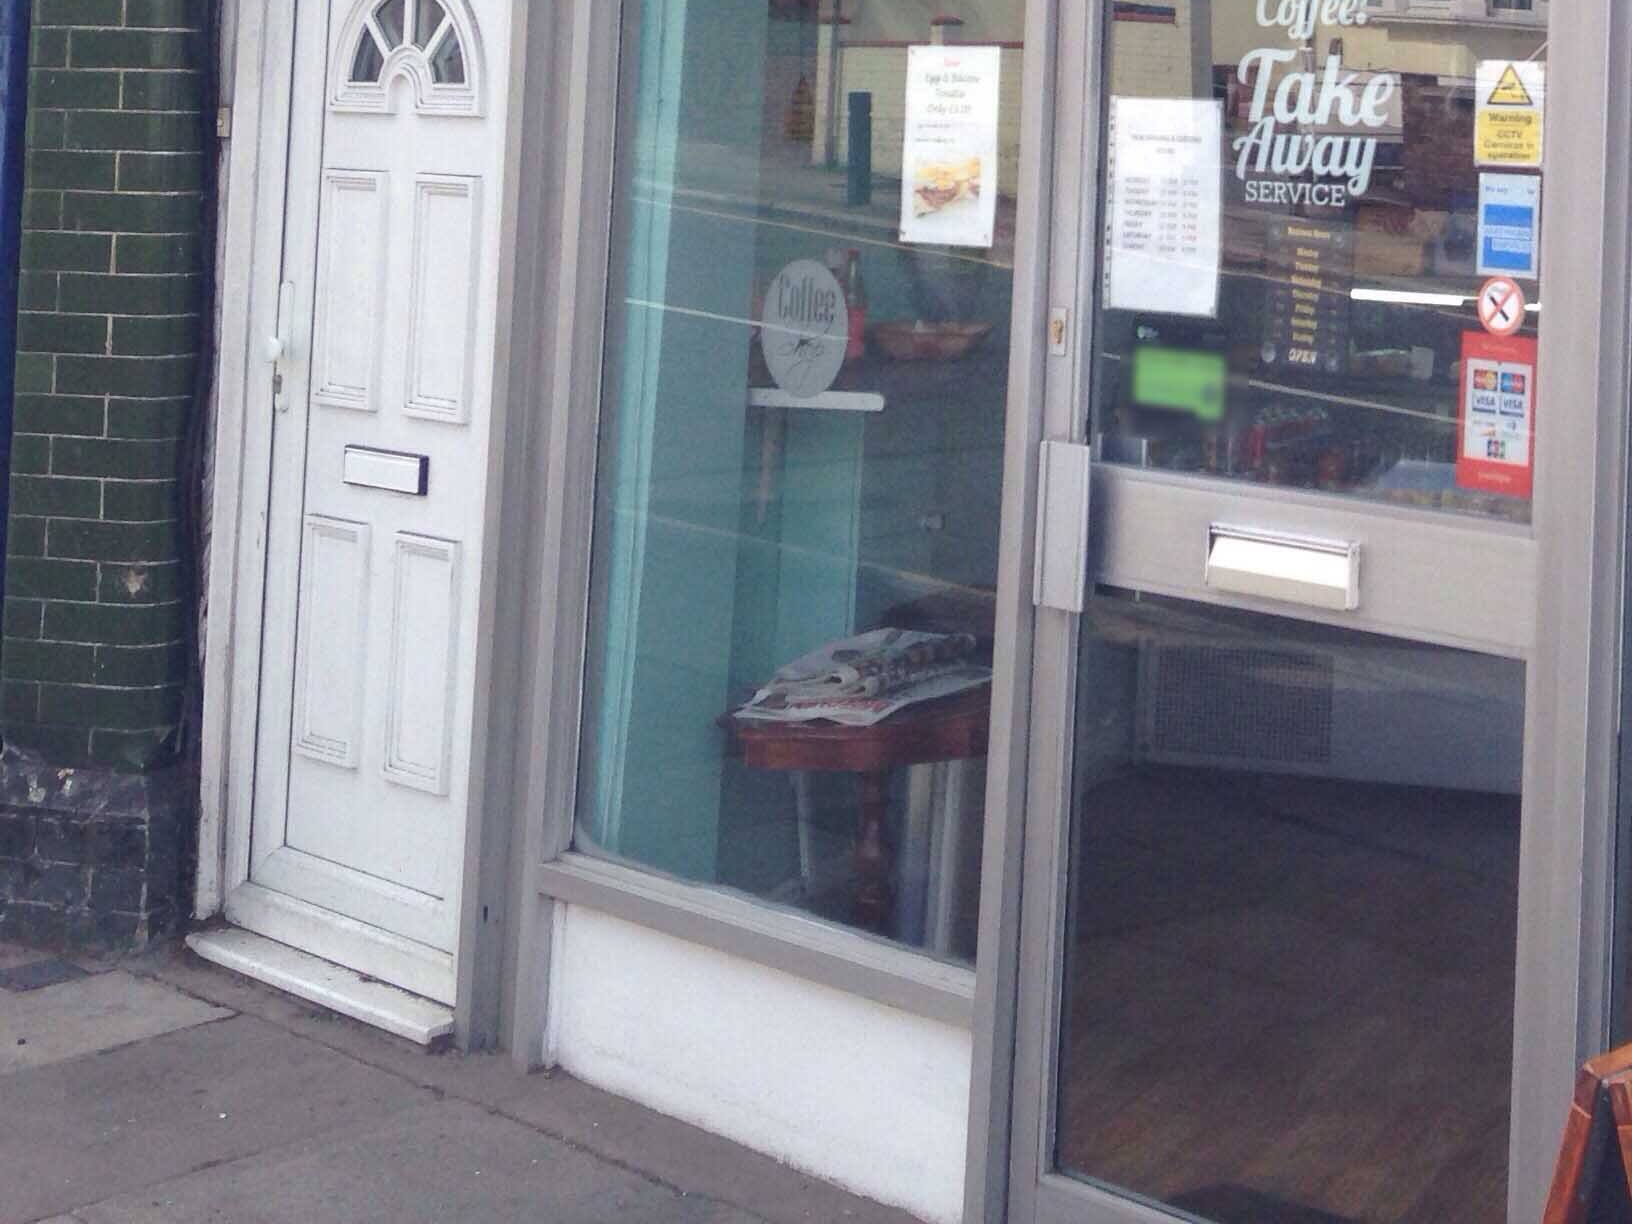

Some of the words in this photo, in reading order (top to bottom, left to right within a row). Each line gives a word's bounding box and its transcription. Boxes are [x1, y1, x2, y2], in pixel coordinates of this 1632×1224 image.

[1237, 48, 1396, 126] Take
[1232, 116, 1377, 196] Away
[1245, 180, 1346, 207] SERVICE
